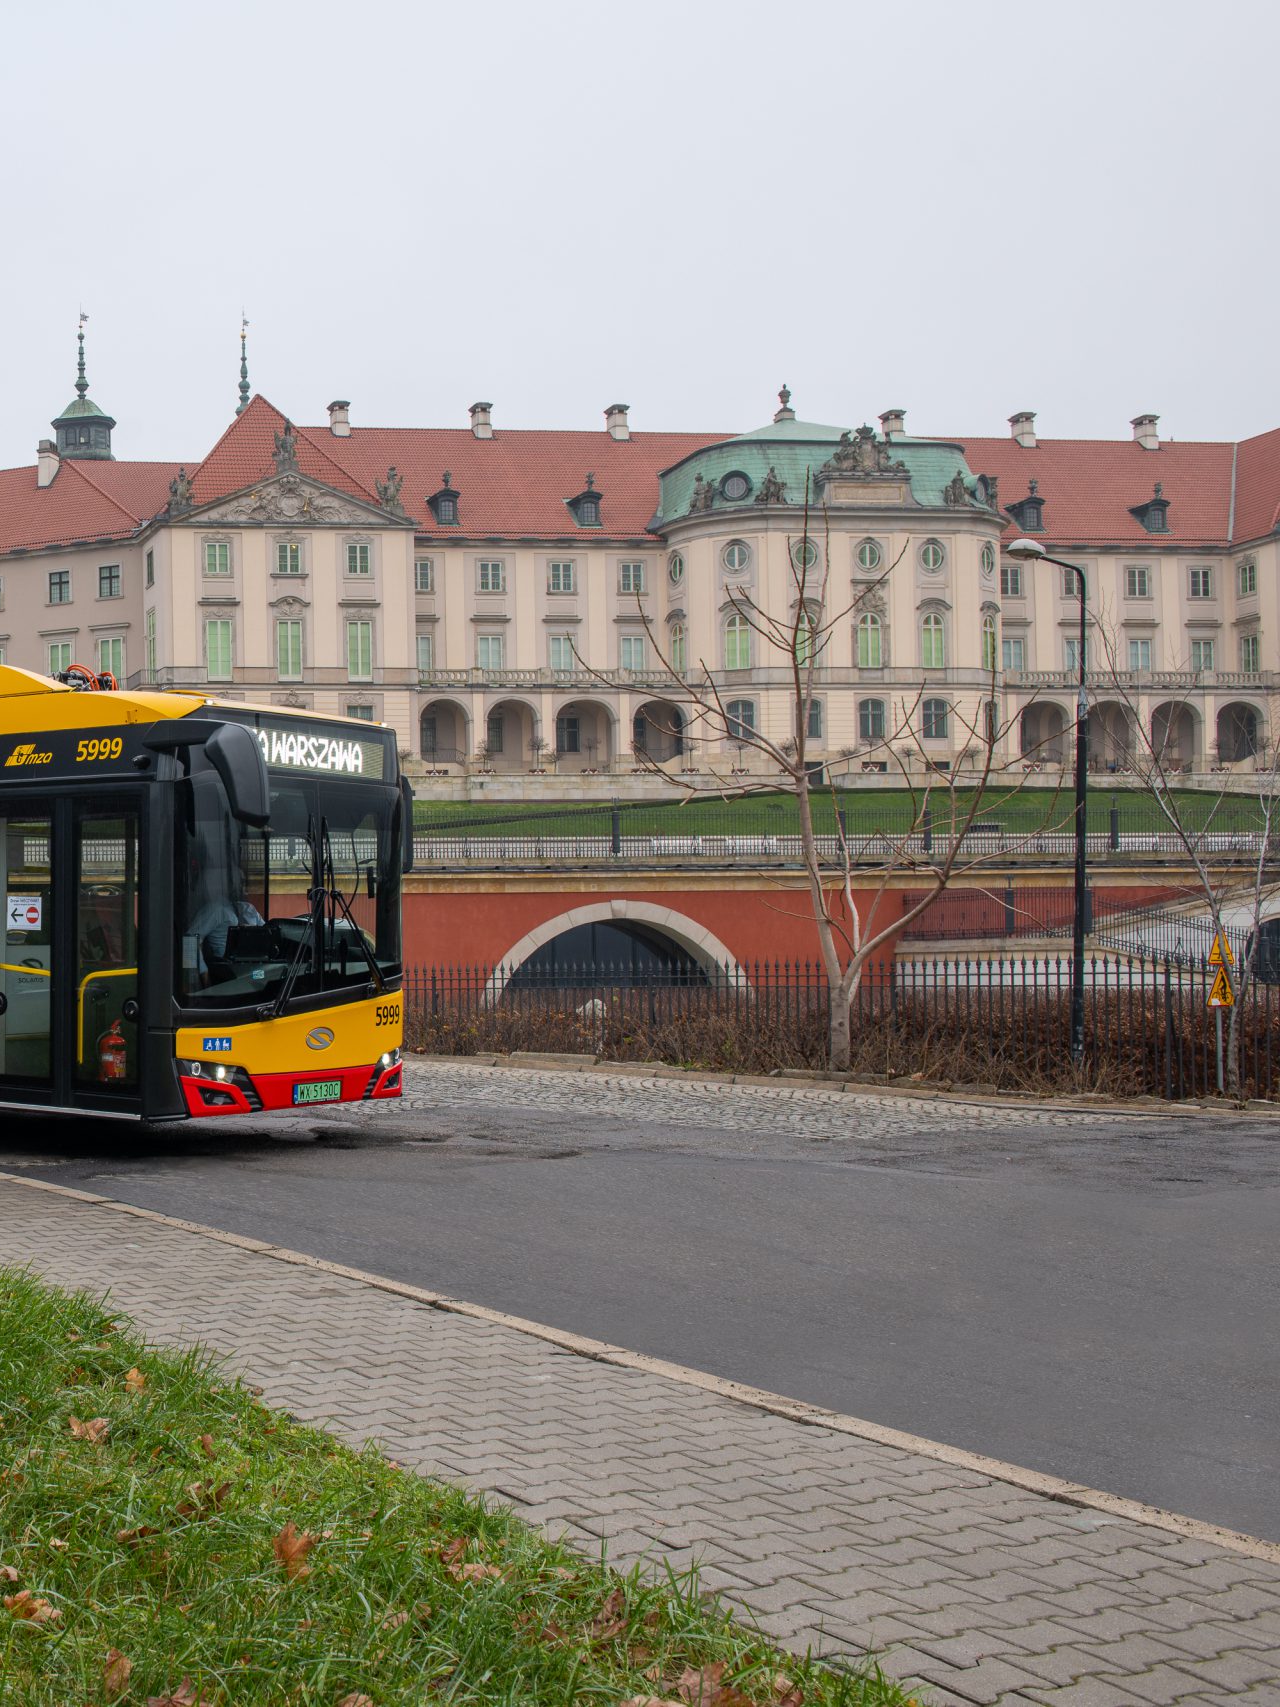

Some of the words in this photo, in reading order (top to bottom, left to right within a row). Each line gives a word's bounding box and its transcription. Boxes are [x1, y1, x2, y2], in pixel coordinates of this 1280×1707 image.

[75, 737, 123, 762] 5999
[271, 731, 362, 773] WARSZAWA
[375, 1004, 400, 1027] 5999
[300, 1085, 310, 1099] WX
